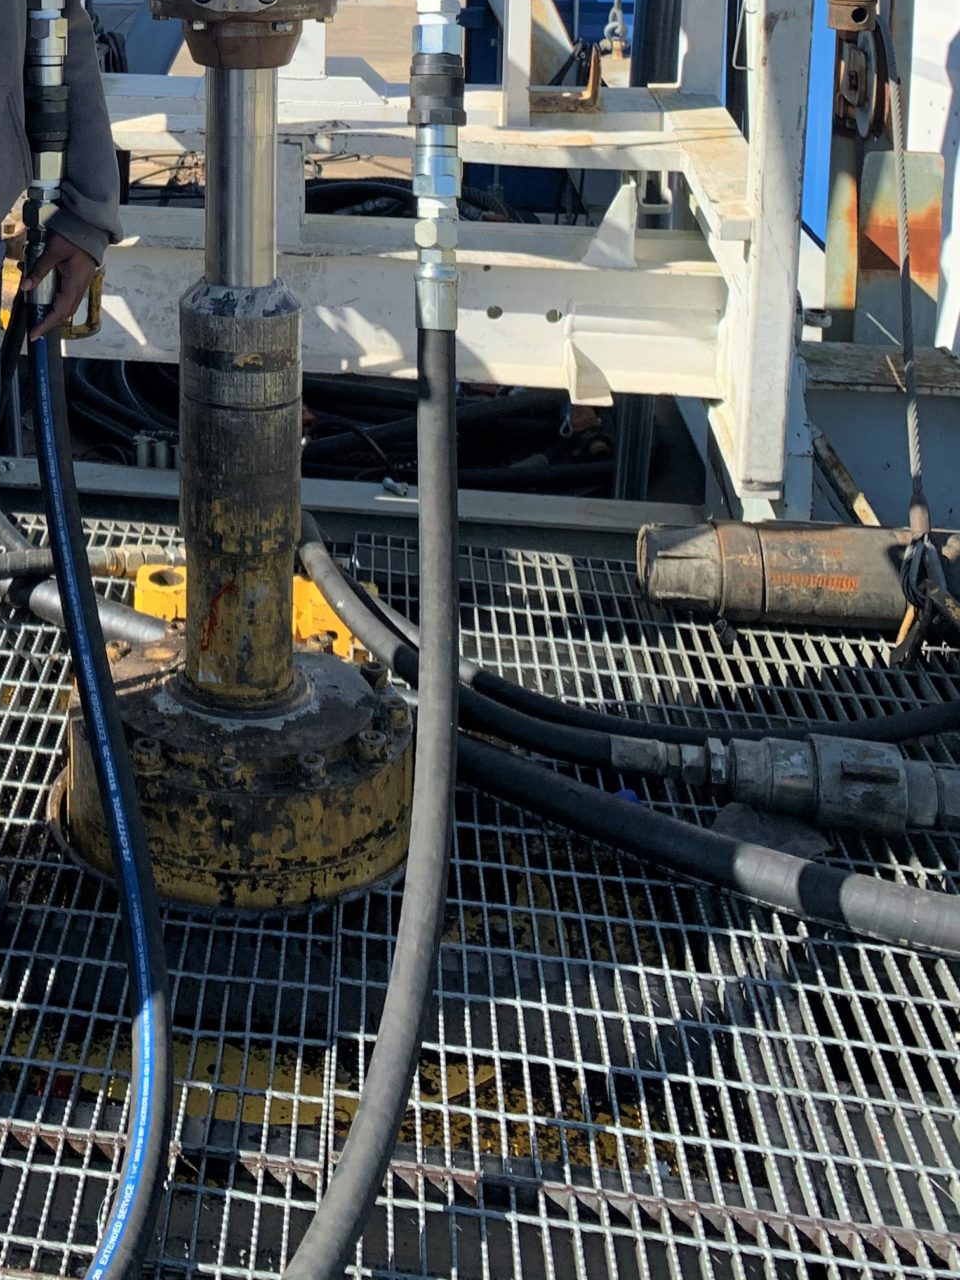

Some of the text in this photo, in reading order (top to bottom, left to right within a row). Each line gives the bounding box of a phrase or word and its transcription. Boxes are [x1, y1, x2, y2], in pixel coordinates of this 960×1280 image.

[81, 654, 96, 692] SERVICE
[89, 692, 107, 743] EXTENDED
[99, 1221, 122, 1265] EXTENDED
[118, 1183, 135, 1220] SERVICE
